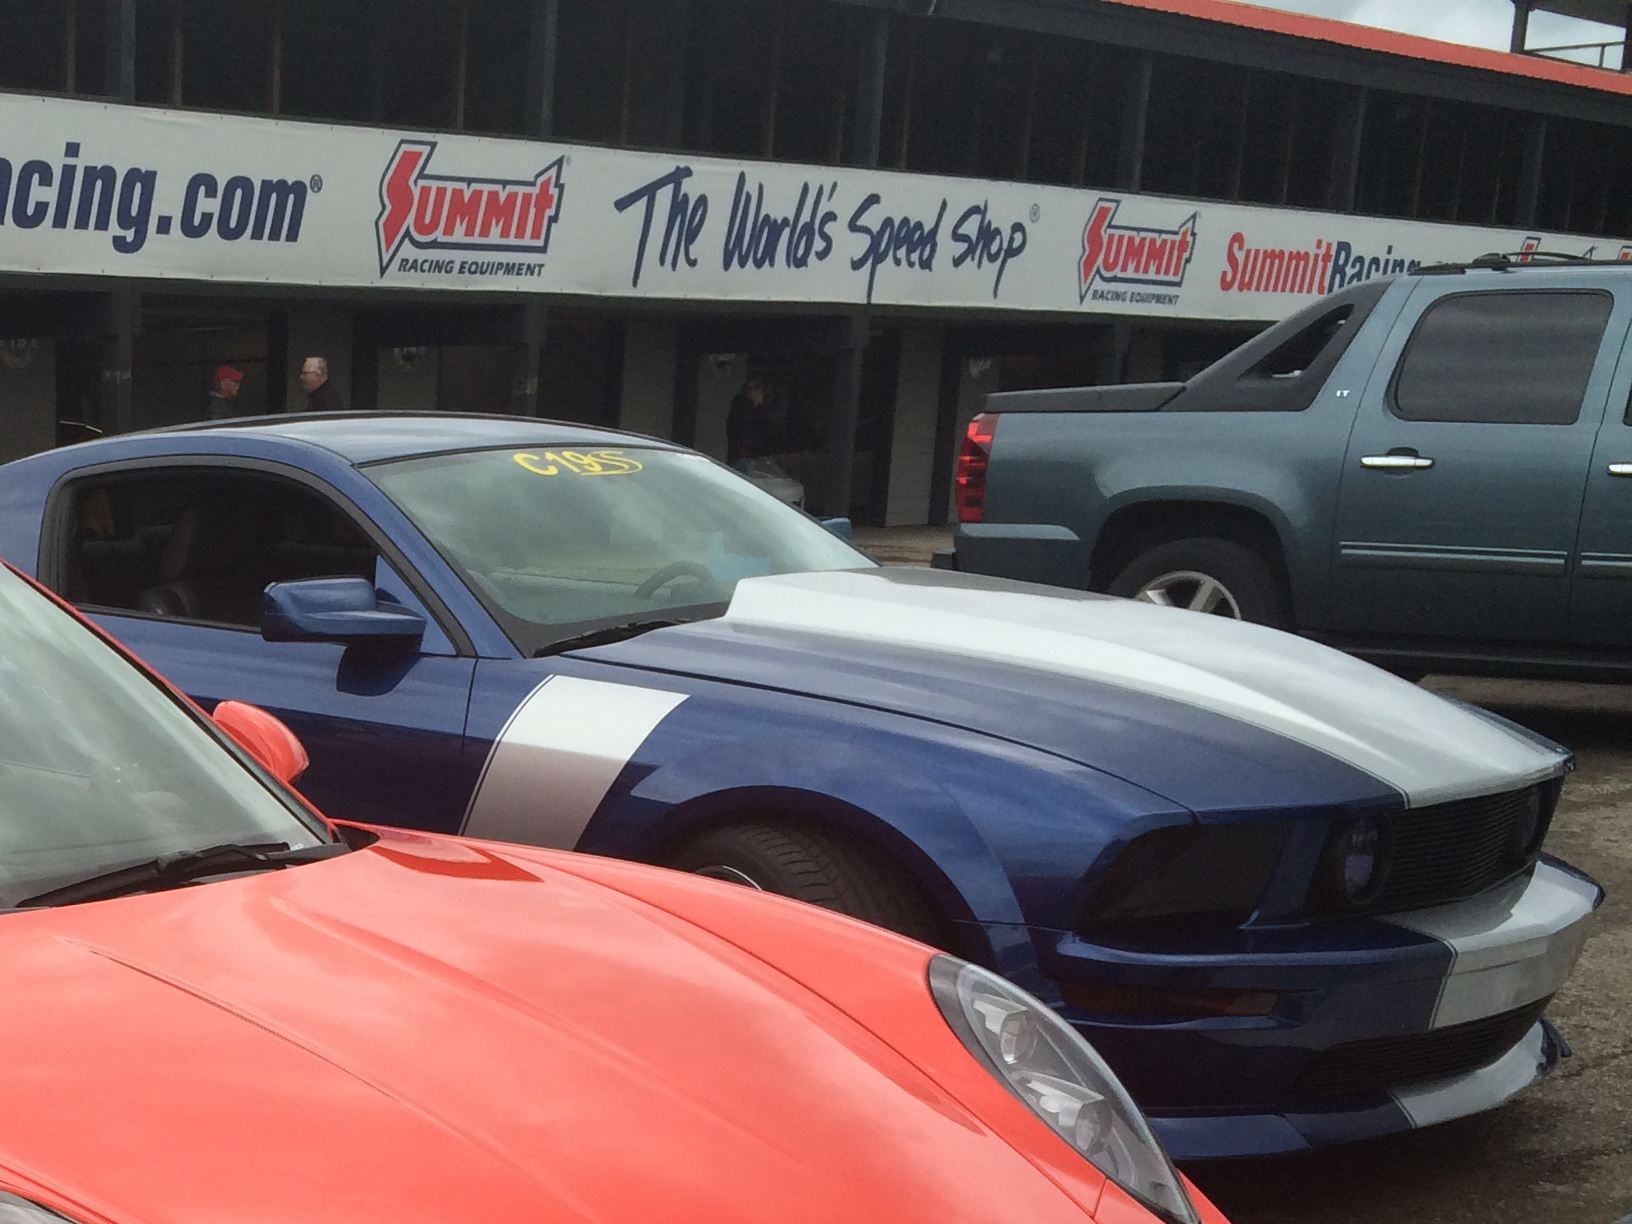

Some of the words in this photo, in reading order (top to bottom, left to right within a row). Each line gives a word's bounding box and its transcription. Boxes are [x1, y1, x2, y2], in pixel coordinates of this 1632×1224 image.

[613, 164, 709, 289] The
[722, 170, 839, 273] World's
[847, 192, 949, 305] Speed
[951, 197, 1028, 300] Shop
[397, 257, 455, 275] RACING
[456, 259, 546, 278] EQUIPMENT
[1219, 231, 1422, 296] SummitRaci
[1090, 289, 1128, 303] RACING
[1129, 291, 1180, 306] EQUIPMENT
